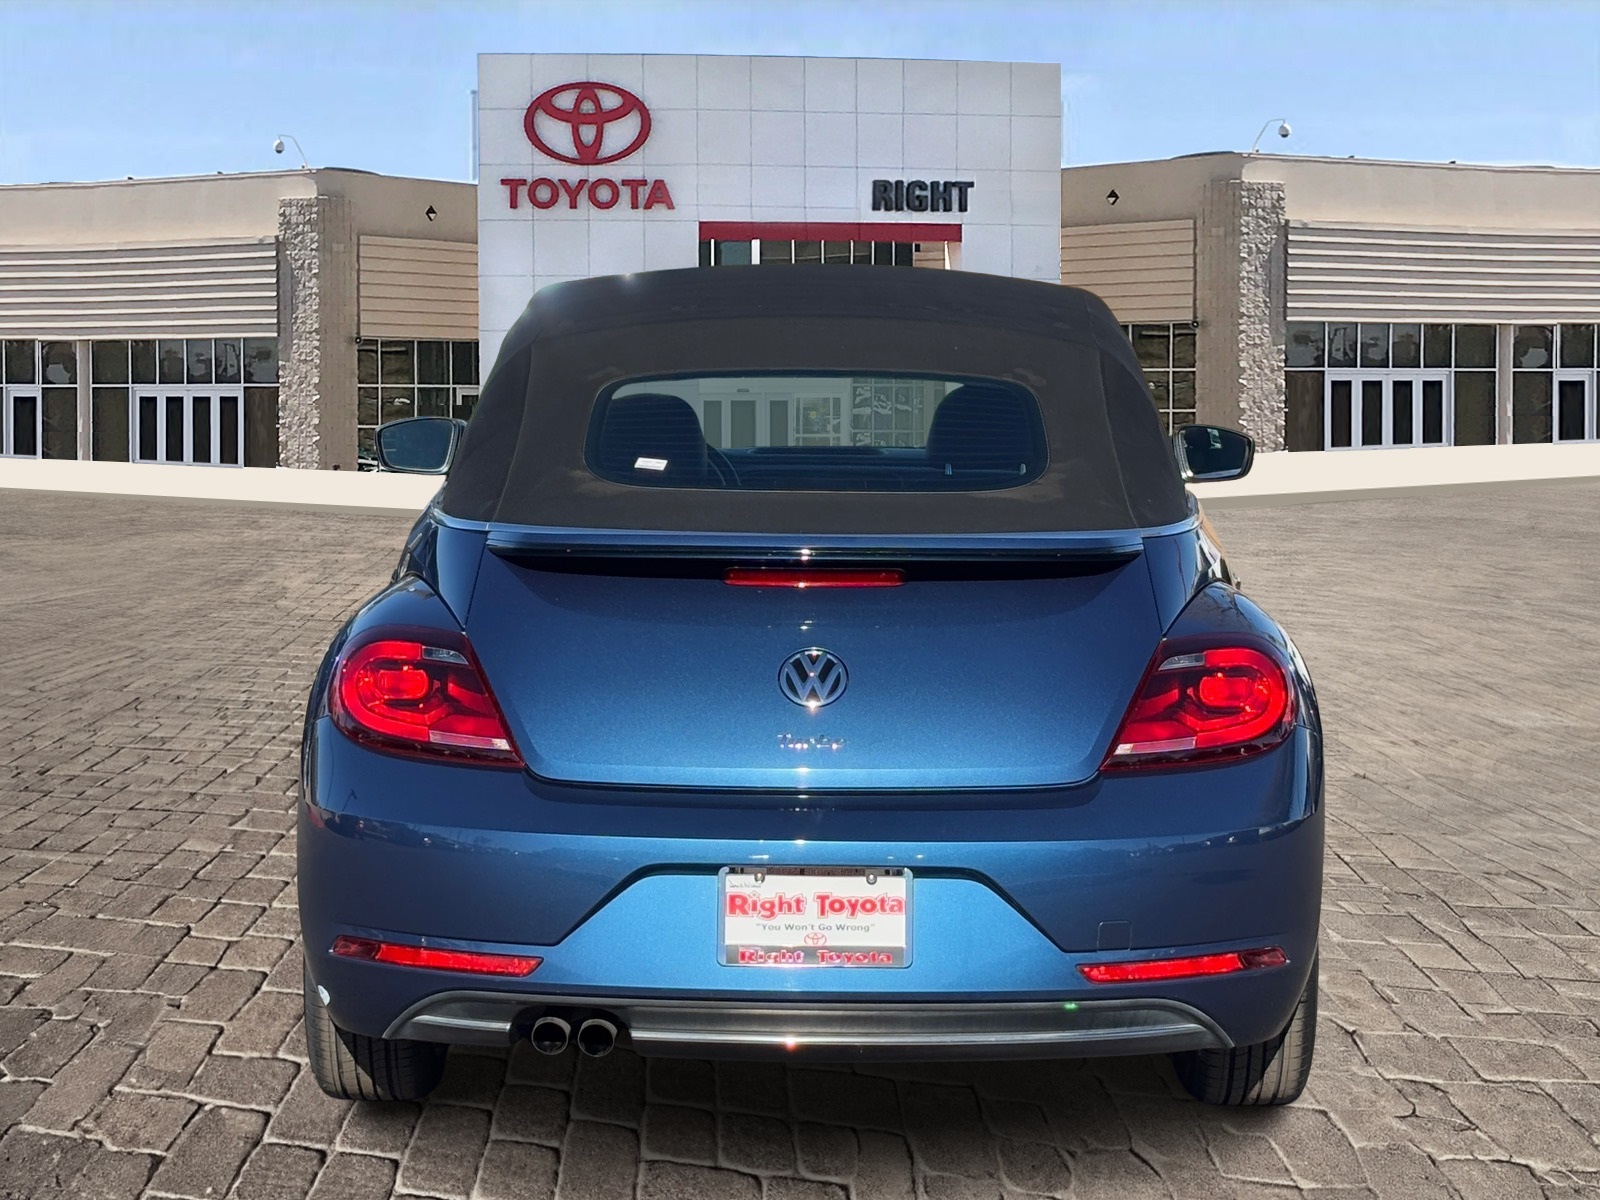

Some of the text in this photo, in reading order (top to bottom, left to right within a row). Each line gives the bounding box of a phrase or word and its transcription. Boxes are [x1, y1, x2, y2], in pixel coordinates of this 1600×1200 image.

[500, 178, 675, 211] TOYOTA
[872, 179, 975, 213] RIGHT
[727, 892, 905, 919] Right Toyota
[756, 923, 875, 933] "You Won't Go Wrong"
[738, 949, 893, 965] Right Toyota
